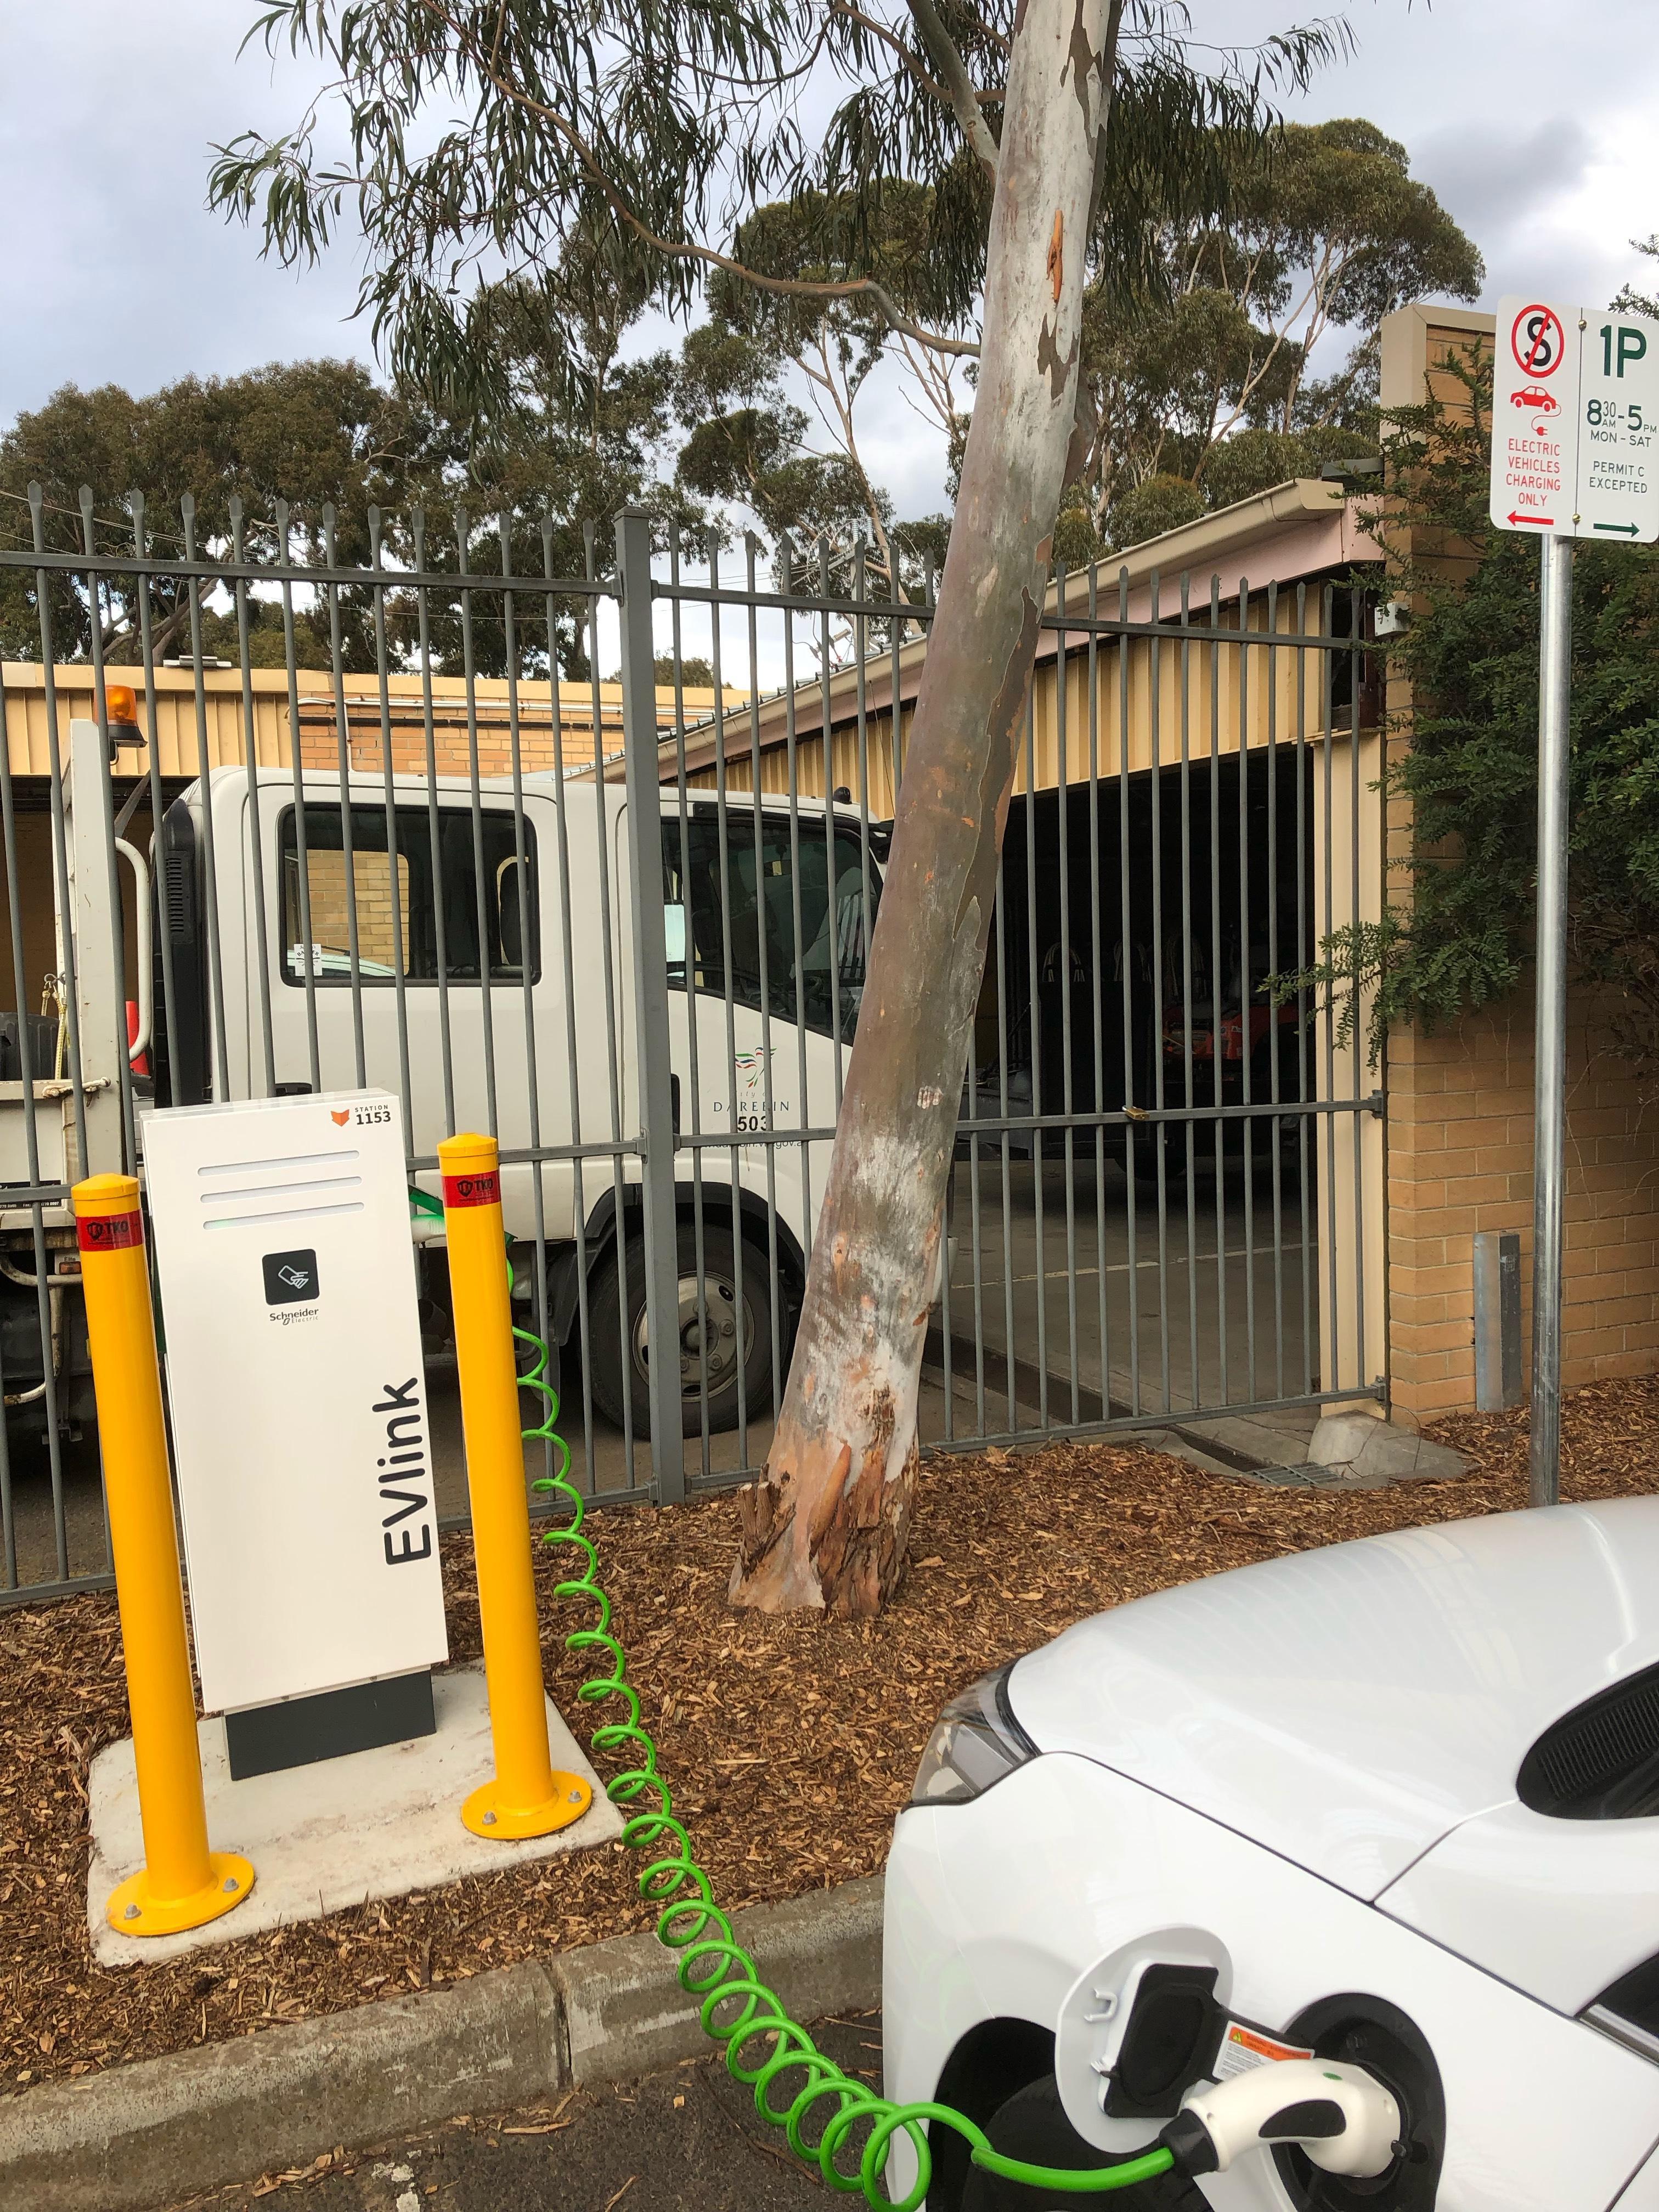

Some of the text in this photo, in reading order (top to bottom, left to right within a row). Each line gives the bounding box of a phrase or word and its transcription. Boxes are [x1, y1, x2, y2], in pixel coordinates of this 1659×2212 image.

[1600, 325, 1647, 378] 1P
[1602, 419, 1616, 428] AM
[1644, 424, 1657, 433] PM
[1509, 438, 1560, 456] ELECTRIC
[1590, 430, 1617, 443] MON
[1629, 435, 1652, 447] SAT
[1508, 455, 1560, 473] VEHICLES
[1593, 460, 1645, 477] PERMIT C
[1506, 473, 1561, 491] CHARGING
[1589, 476, 1647, 493] EXCEPTED
[1518, 492, 1548, 506] ONLY
[354, 1104, 388, 1113] STATION
[356, 1111, 391, 1125] 1153
[269, 1308, 319, 1321] Schneider
[372, 1377, 431, 1565] EVlink
